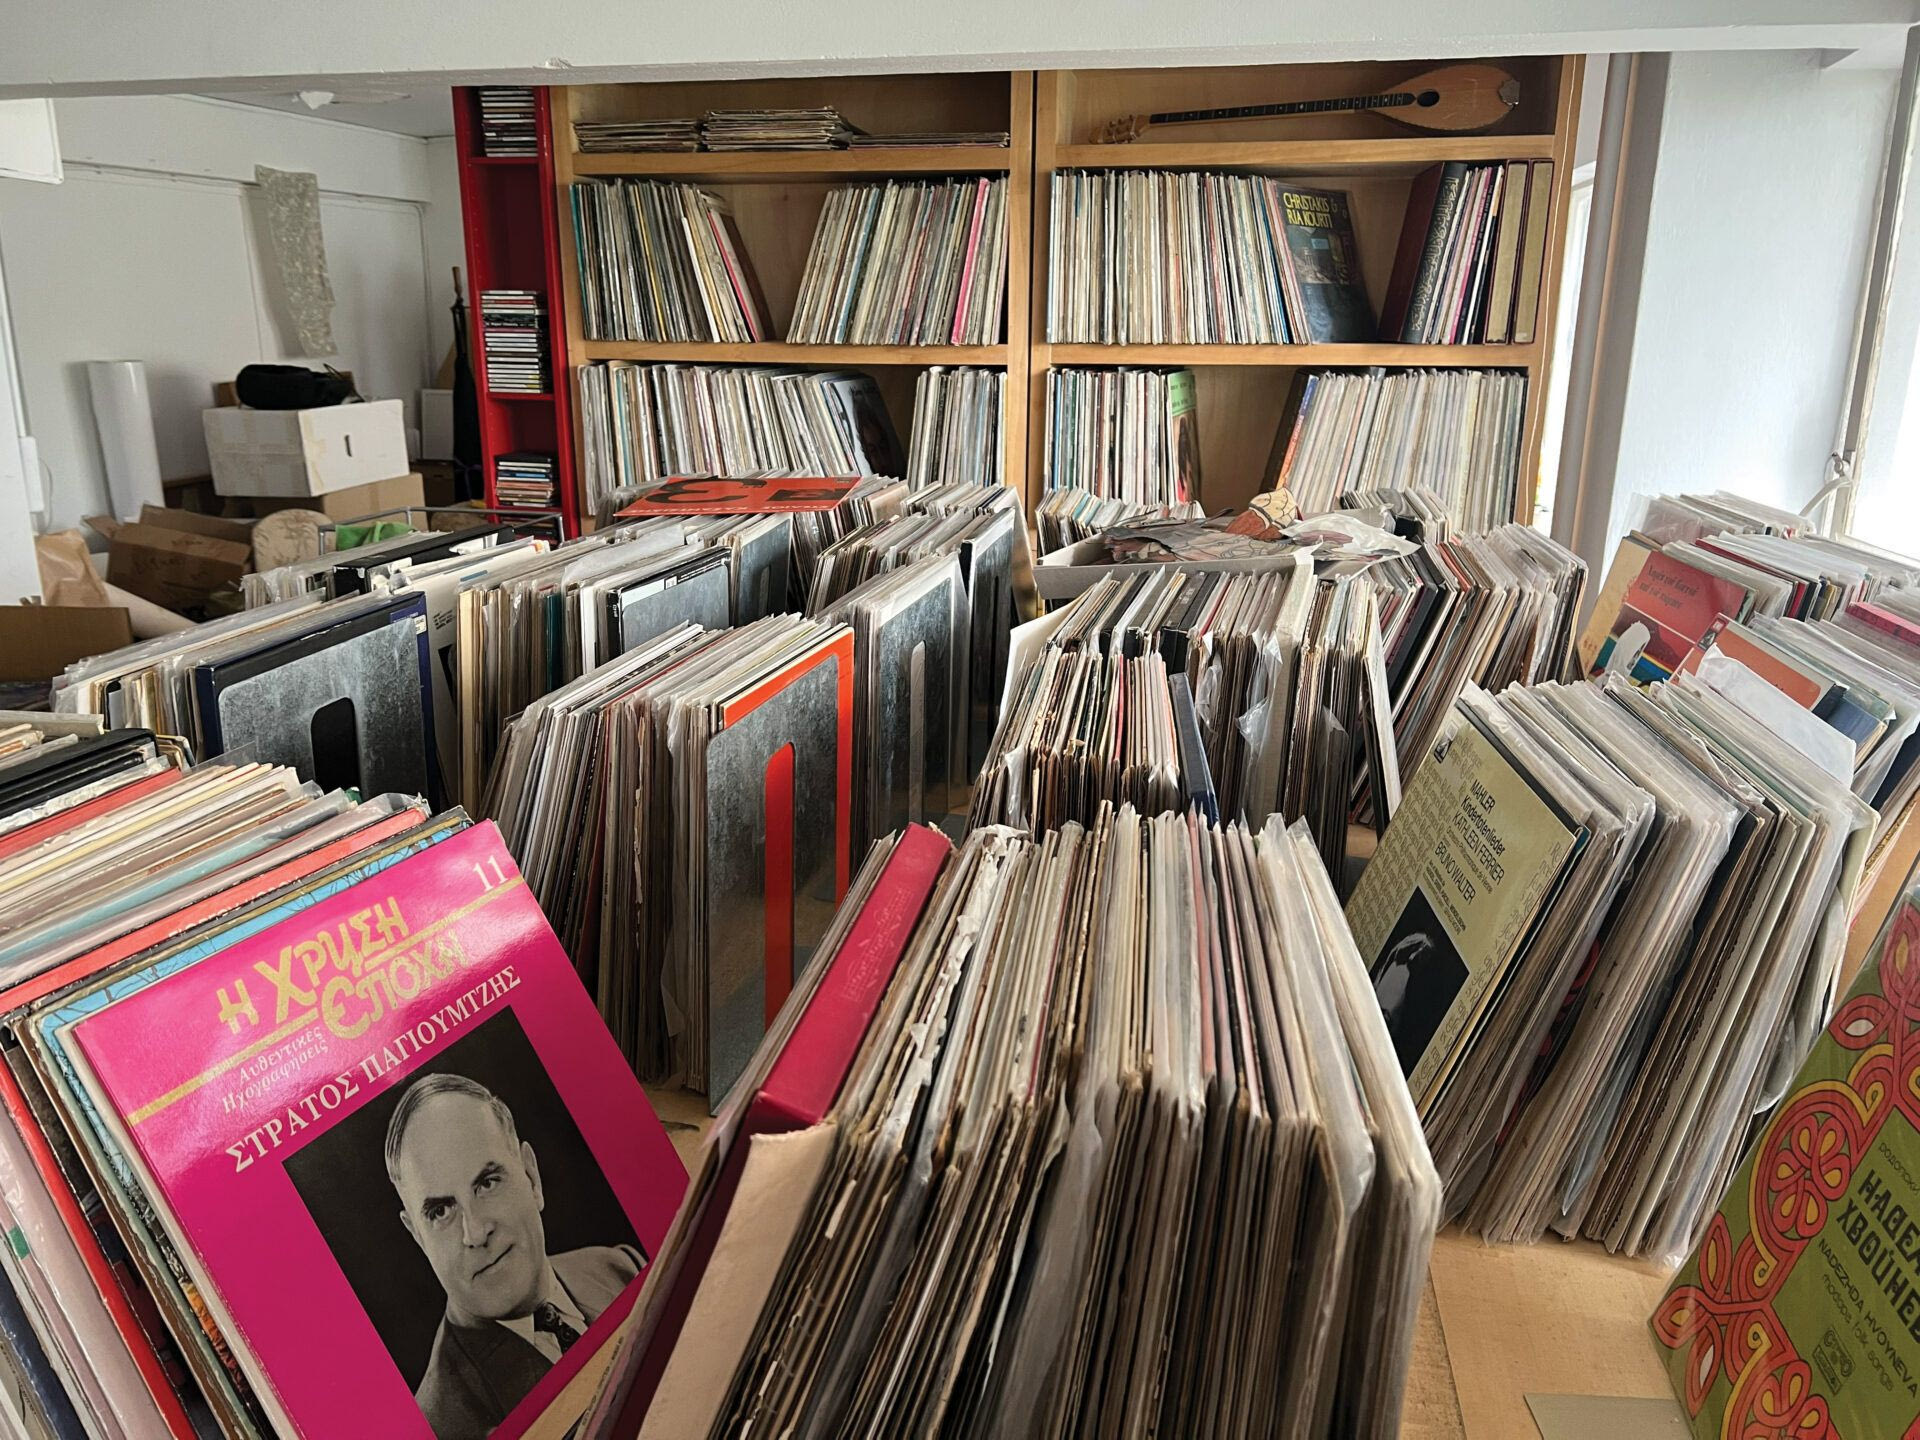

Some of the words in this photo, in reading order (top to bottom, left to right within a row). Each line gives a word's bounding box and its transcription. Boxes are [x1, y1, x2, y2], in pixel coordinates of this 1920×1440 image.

[1283, 192, 1330, 212] CHRISTAKIS
[1286, 209, 1304, 226] RIA
[1302, 210, 1333, 229] KOURTI
[1460, 795, 1505, 857] Kindertotenlieder
[1470, 779, 1496, 814] MAHLER
[473, 855, 508, 892] 11
[1434, 841, 1456, 874] BRUNO
[1451, 863, 1476, 905] WALTER
[1452, 811, 1483, 854] KATHLEEN
[1479, 844, 1505, 886] FERRIER
[216, 979, 260, 1035] Η
[253, 896, 410, 1025] ΧΡΥΣΗ
[226, 1072, 360, 1173] ΣΤΡΑΤΟΣ
[358, 965, 521, 1083] ΠΑΓΙΟΥΜΤΖΗΣ
[1819, 1238, 1864, 1313] NADEZHDA
[1864, 1311, 1918, 1399] HVOYNEVA
[1868, 1350, 1893, 1392] songs
